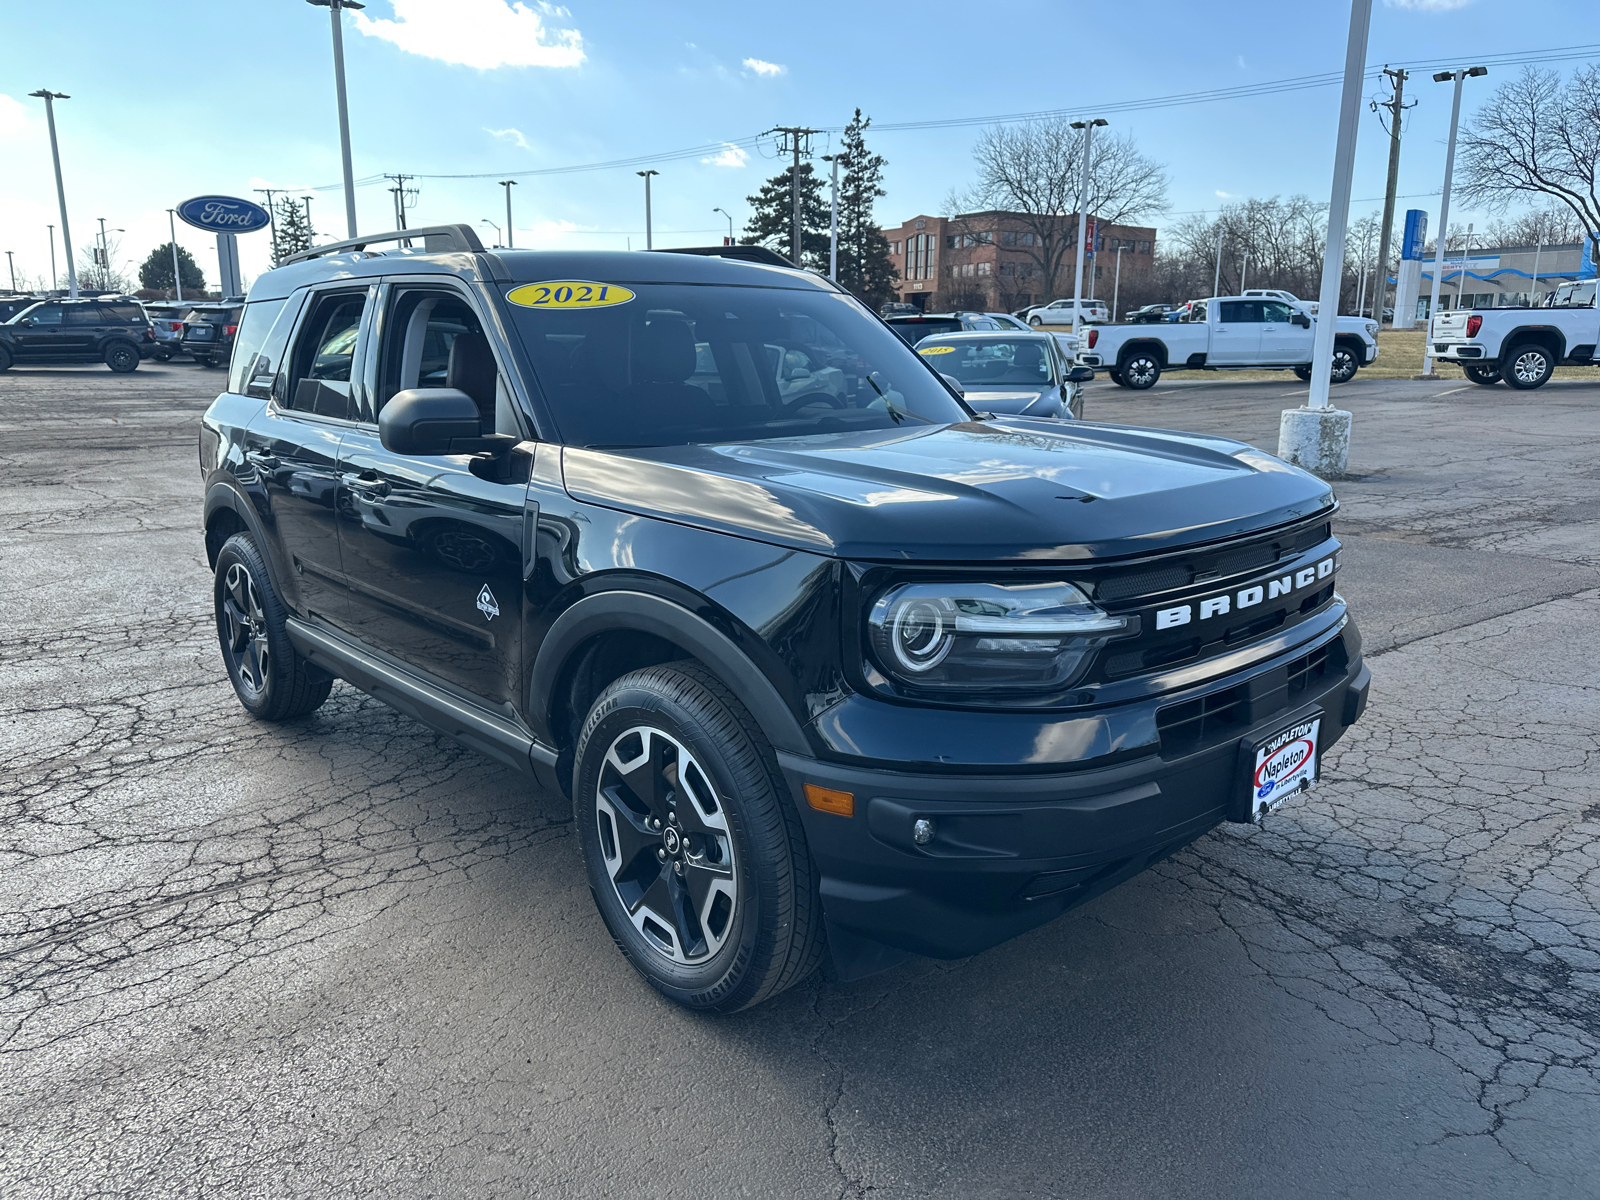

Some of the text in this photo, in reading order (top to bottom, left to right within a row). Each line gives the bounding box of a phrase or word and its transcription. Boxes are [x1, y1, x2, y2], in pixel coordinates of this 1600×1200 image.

[200, 202, 252, 226] Ford
[532, 286, 609, 305] 2021
[1156, 558, 1333, 630] BRONCO
[575, 697, 619, 766] TRAVELSTAR
[1263, 748, 1304, 781] Napleton
[1281, 769, 1308, 788] Libertyville
[691, 943, 751, 1004] TRAVELSTAR
